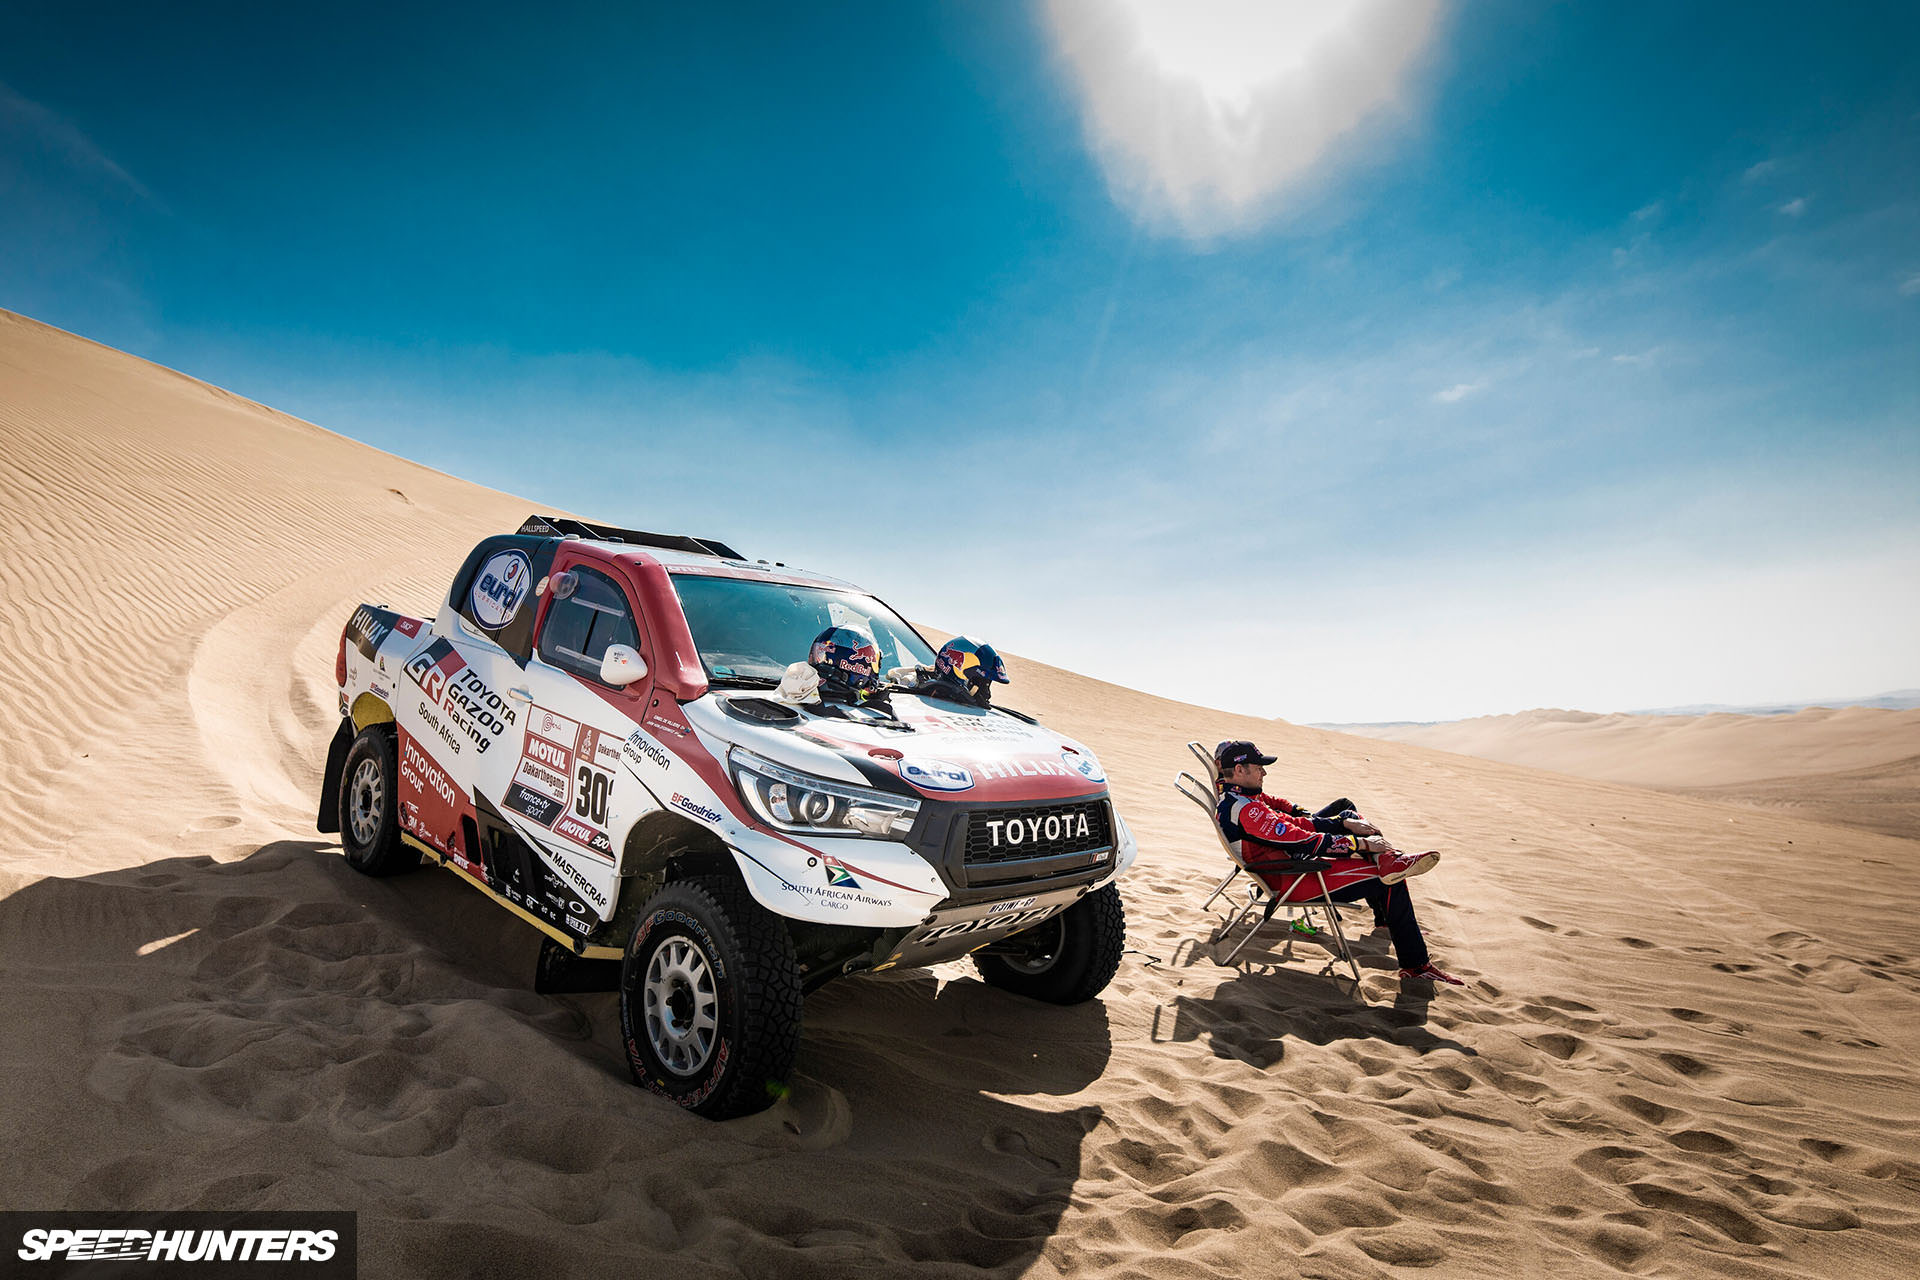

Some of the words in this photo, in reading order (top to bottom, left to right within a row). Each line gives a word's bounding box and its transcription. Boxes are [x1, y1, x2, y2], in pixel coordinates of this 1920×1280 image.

[520, 525, 550, 533] HALLSPEED
[480, 573, 523, 613] eurol
[352, 608, 389, 645] HILUX
[400, 621, 413, 631] SKF
[406, 652, 446, 704] GR
[840, 659, 858, 672] Red
[448, 683, 504, 736] GAZOO
[460, 668, 517, 726] TOYOTA
[418, 702, 440, 732] South
[438, 724, 461, 755] Africa
[443, 698, 491, 754] Racing
[528, 737, 566, 770] MOTUL
[623, 742, 642, 764] Group
[628, 730, 671, 771] Innovation
[404, 737, 455, 807] Innovation
[522, 762, 565, 790] Dakarthegame
[976, 760, 1076, 780] HILUX
[551, 789, 565, 799] .com
[576, 766, 615, 829] 30
[671, 792, 722, 823] BFGoodrich
[526, 804, 544, 819] sport
[559, 819, 591, 842] MOTUL
[591, 835, 610, 850] 300
[986, 813, 1090, 847] TOYOTA
[781, 882, 812, 894] SOUTH
[815, 887, 854, 900] AFRICAN
[854, 894, 892, 906] AIRWAYS
[820, 899, 849, 910] CARGO
[912, 904, 1063, 944] TOYOTA
